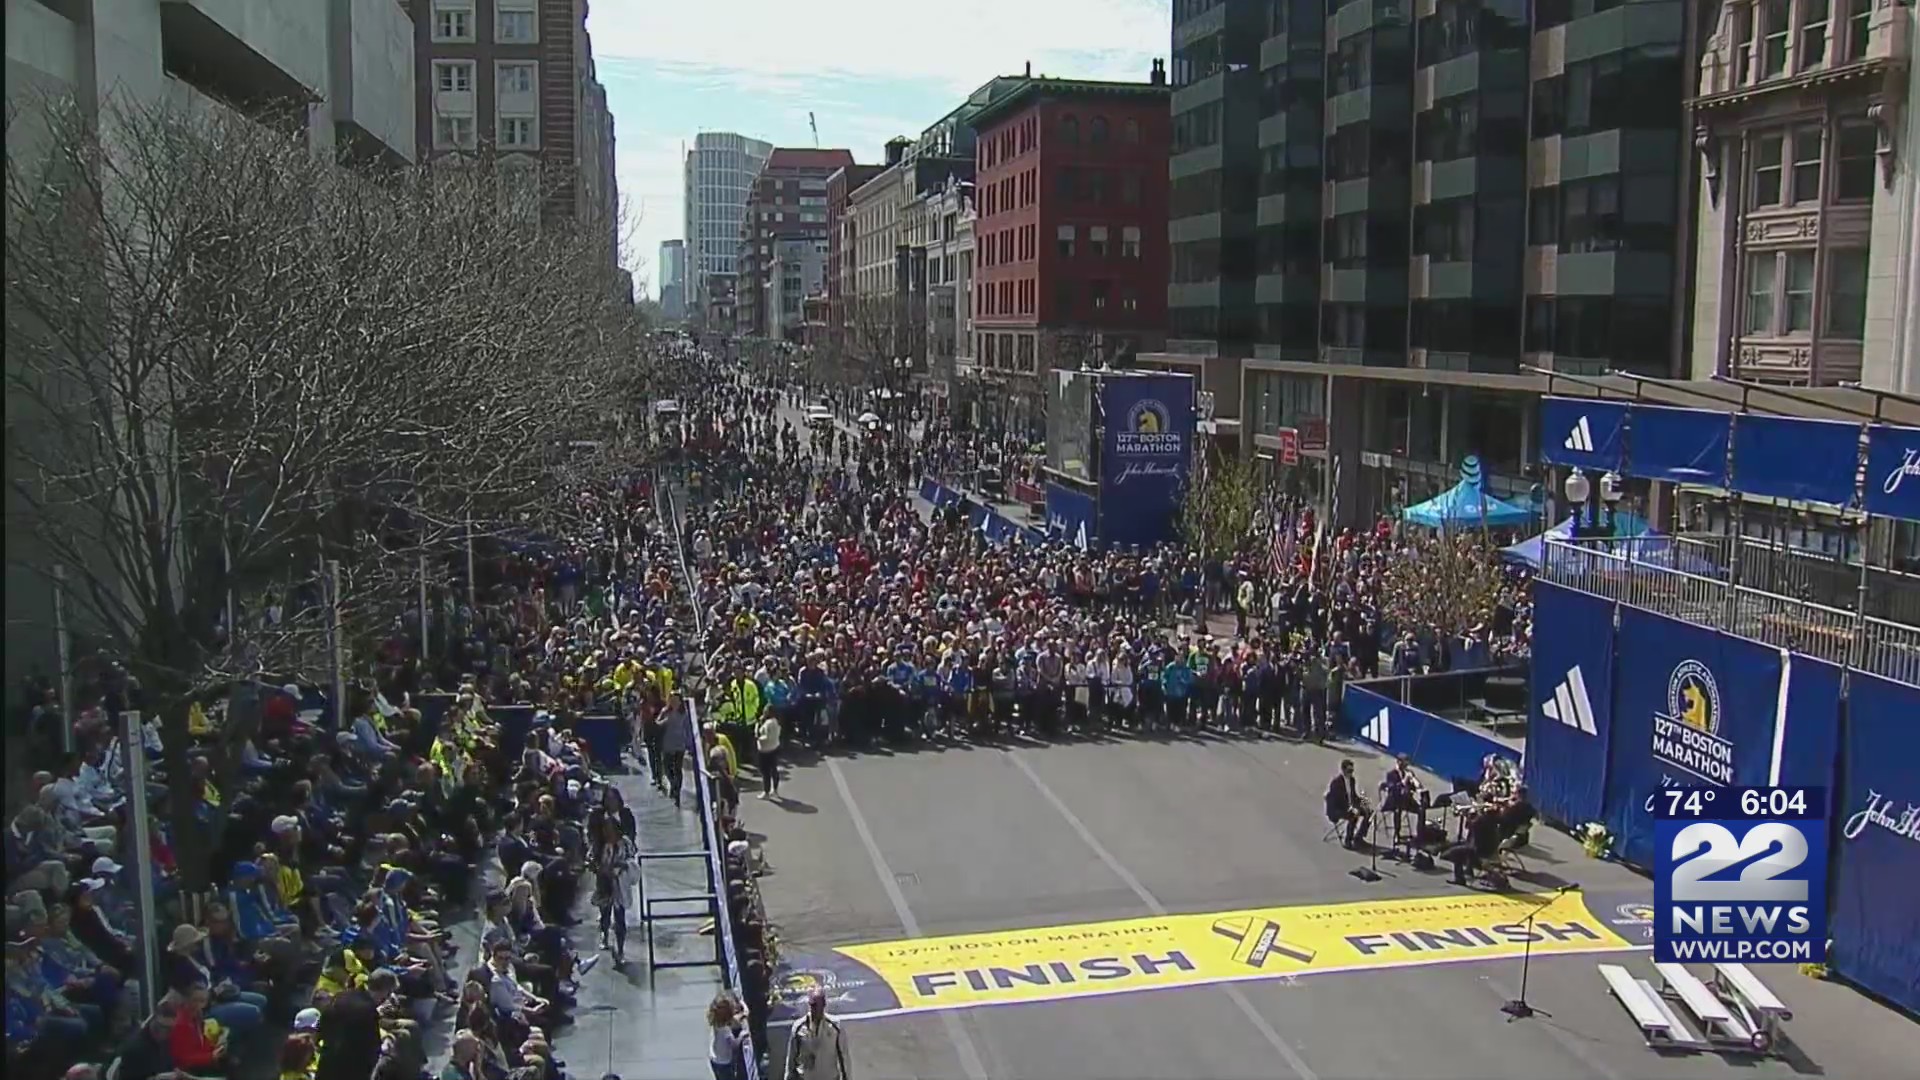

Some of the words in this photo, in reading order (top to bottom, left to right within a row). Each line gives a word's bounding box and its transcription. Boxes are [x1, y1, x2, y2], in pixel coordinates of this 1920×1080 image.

[1116, 443, 1181, 453] MARATHON
[1140, 433, 1180, 443] BOSTON
[1654, 716, 1682, 737] 127TH
[1682, 728, 1732, 764] BOSTON
[1652, 734, 1733, 783] MARATHON
[1358, 905, 1440, 915] BOSTON
[949, 937, 1038, 951] BOSTON
[1048, 925, 1170, 942] MARATHON
[1344, 921, 1602, 955] FINISH
[912, 950, 1196, 997] FINISH
